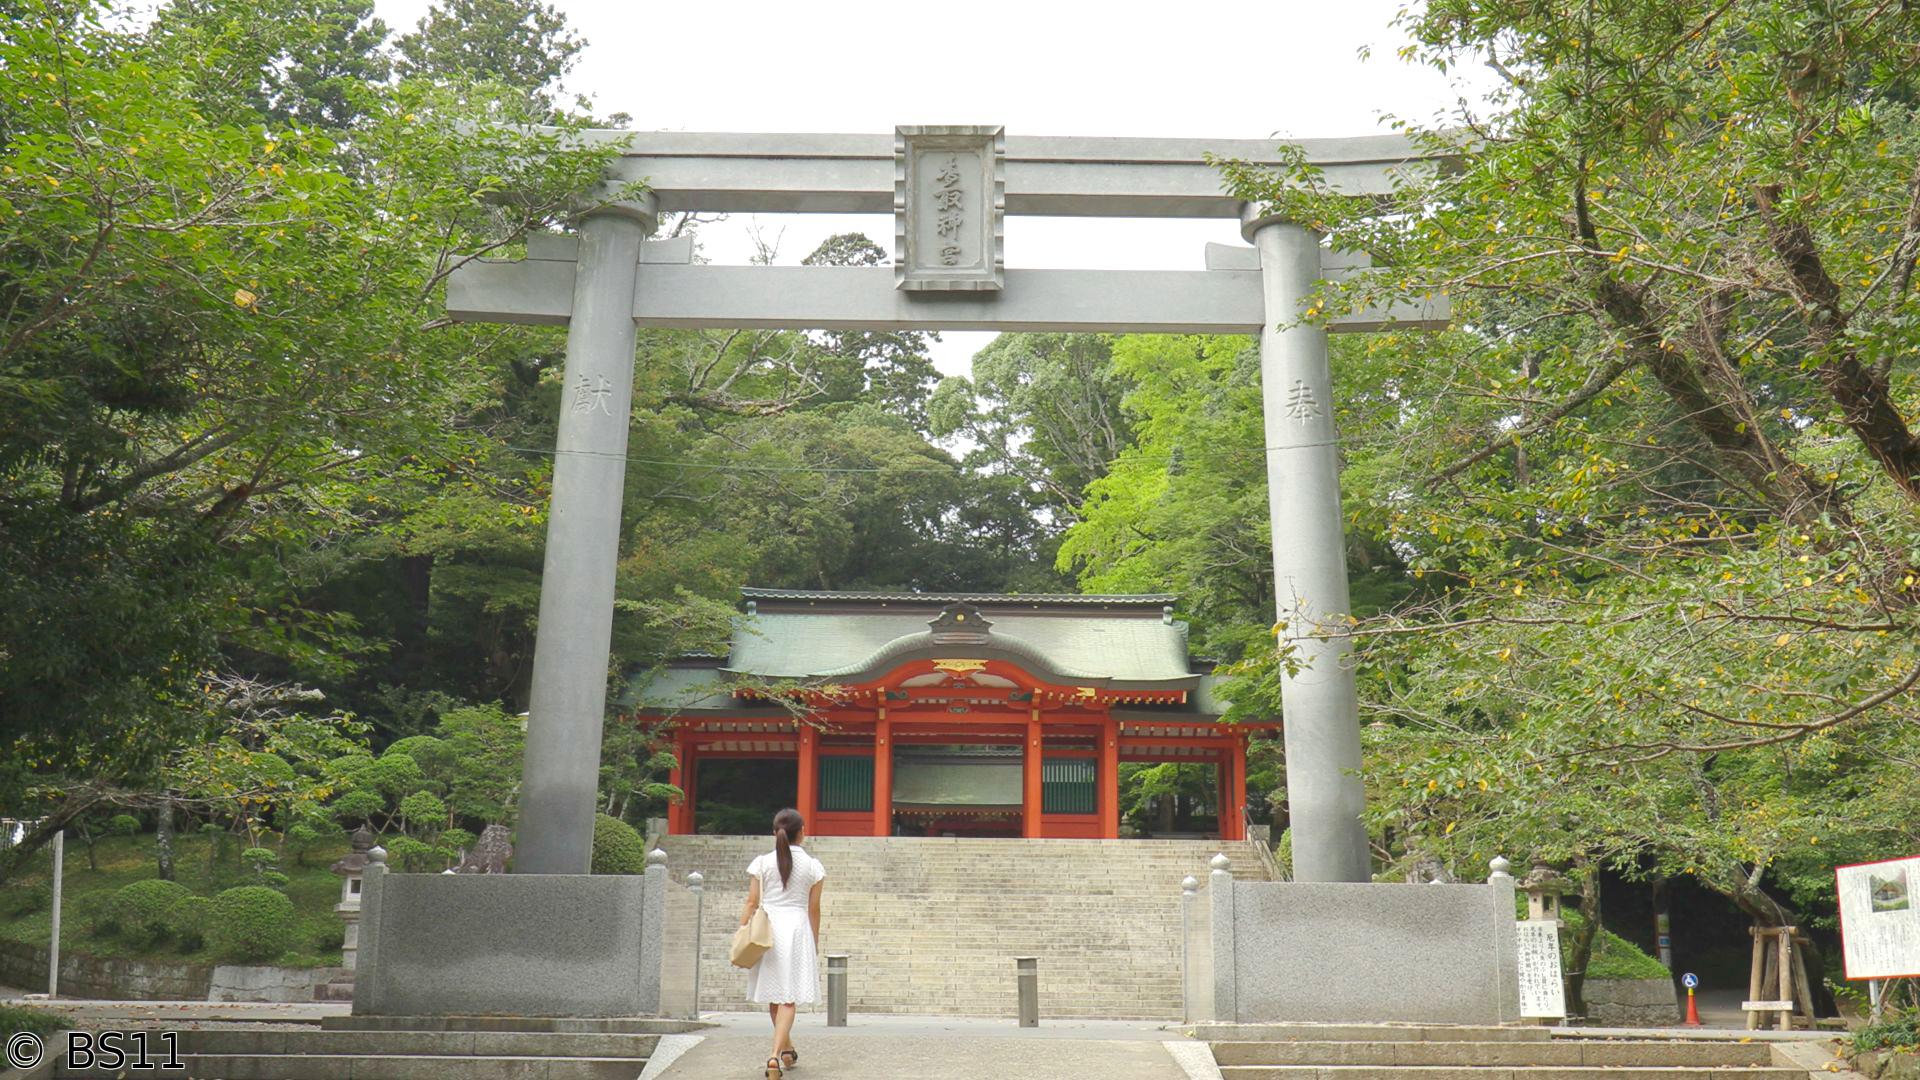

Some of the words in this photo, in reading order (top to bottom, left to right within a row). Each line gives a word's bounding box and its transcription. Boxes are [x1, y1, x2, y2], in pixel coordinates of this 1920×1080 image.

[932, 152, 964, 266] 香取神宮
[1284, 379, 1323, 427] 奉
